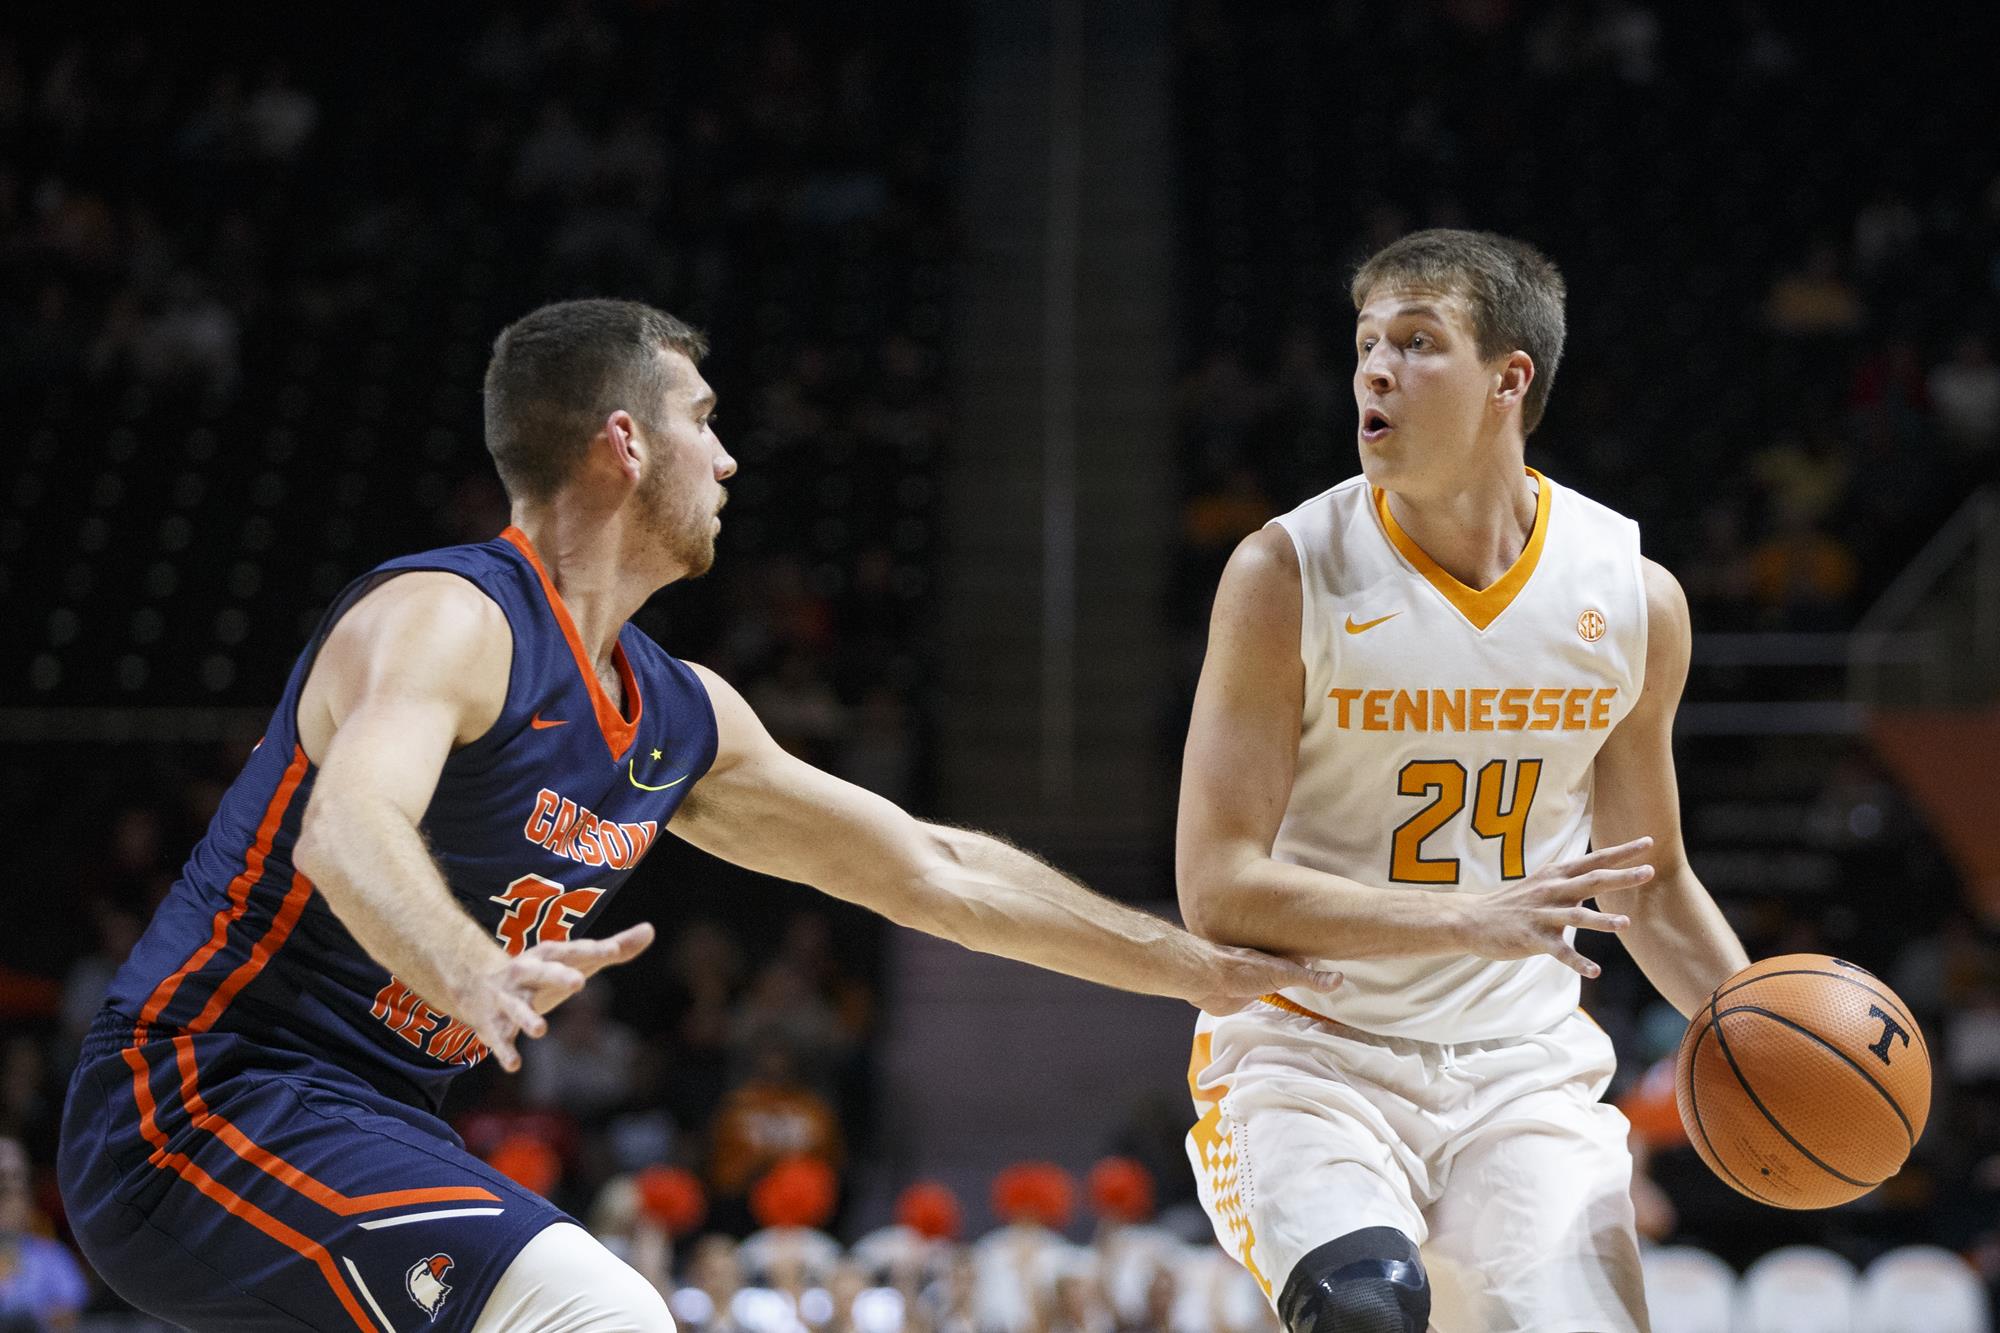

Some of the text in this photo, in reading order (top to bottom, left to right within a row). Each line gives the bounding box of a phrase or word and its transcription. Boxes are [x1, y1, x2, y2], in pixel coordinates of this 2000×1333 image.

[1580, 613, 1603, 638] SEC
[1328, 687, 1617, 731] TENNESSEE
[1389, 758, 1543, 884] 24
[1868, 1004, 1910, 1066] T
